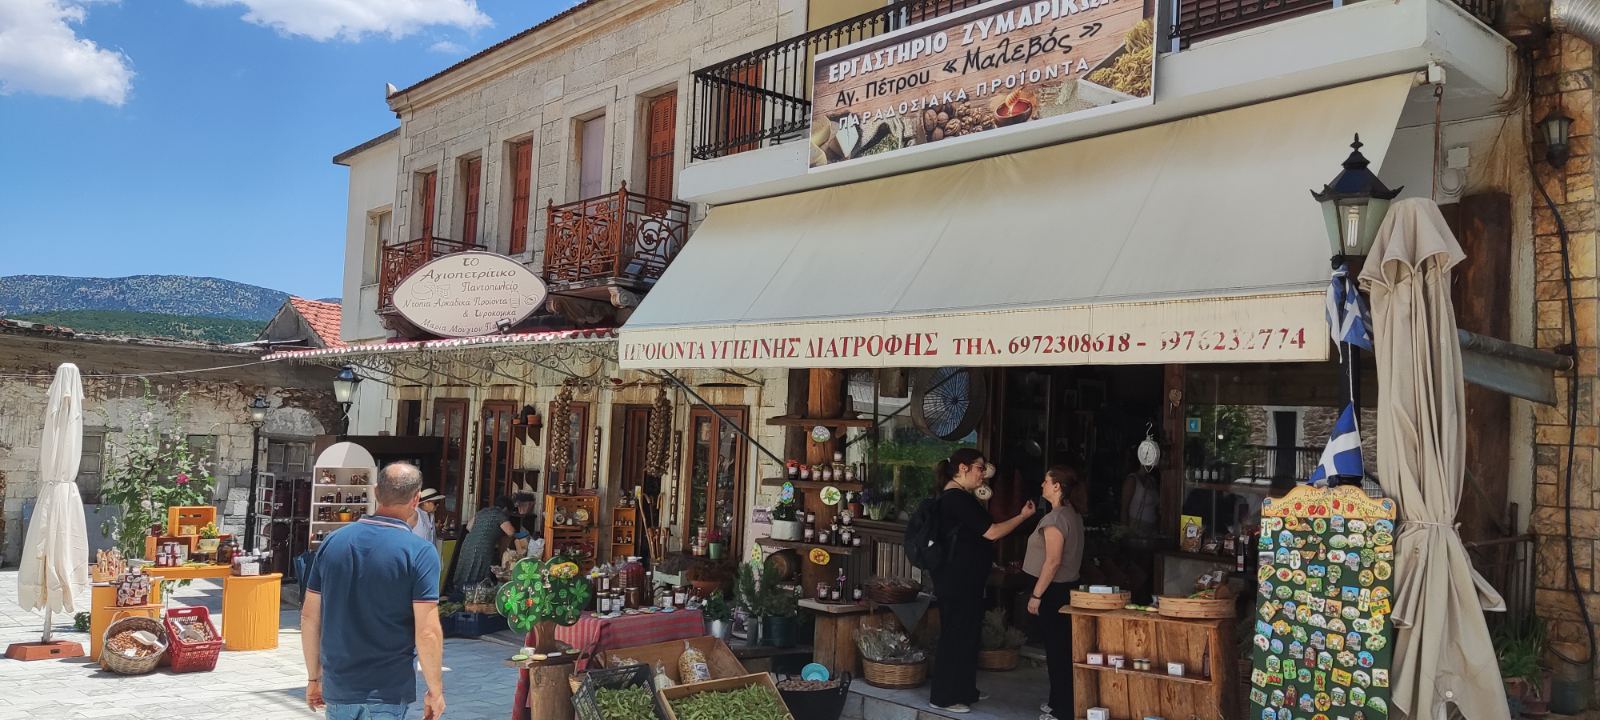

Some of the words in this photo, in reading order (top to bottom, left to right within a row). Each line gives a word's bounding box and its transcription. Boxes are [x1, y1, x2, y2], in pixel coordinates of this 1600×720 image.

[828, 31, 949, 83] ΕΡΓΑΣΤΗΡΙΟ
[961, 0, 1118, 46] ΖΥΜΑΡΙΚ
[836, 90, 859, 107] Αγ.
[866, 70, 930, 98] Πέτρου
[962, 27, 1073, 75] Μαλεβός
[839, 88, 967, 129] ΠΑΡΑΔΟΣΙΑΚΑ
[976, 57, 1089, 96] ΠΡΟΪΟΝΤΑ
[420, 269, 516, 282] Αγιοπετρίτικο
[711, 337, 800, 360] ΥΓΙΕΙΝΗΣ
[805, 332, 938, 359] ΔΙΑΤΡΟΦΗΣ
[953, 337, 1002, 355] ΤΗΛ.
[1009, 332, 1131, 355] 6972308618
